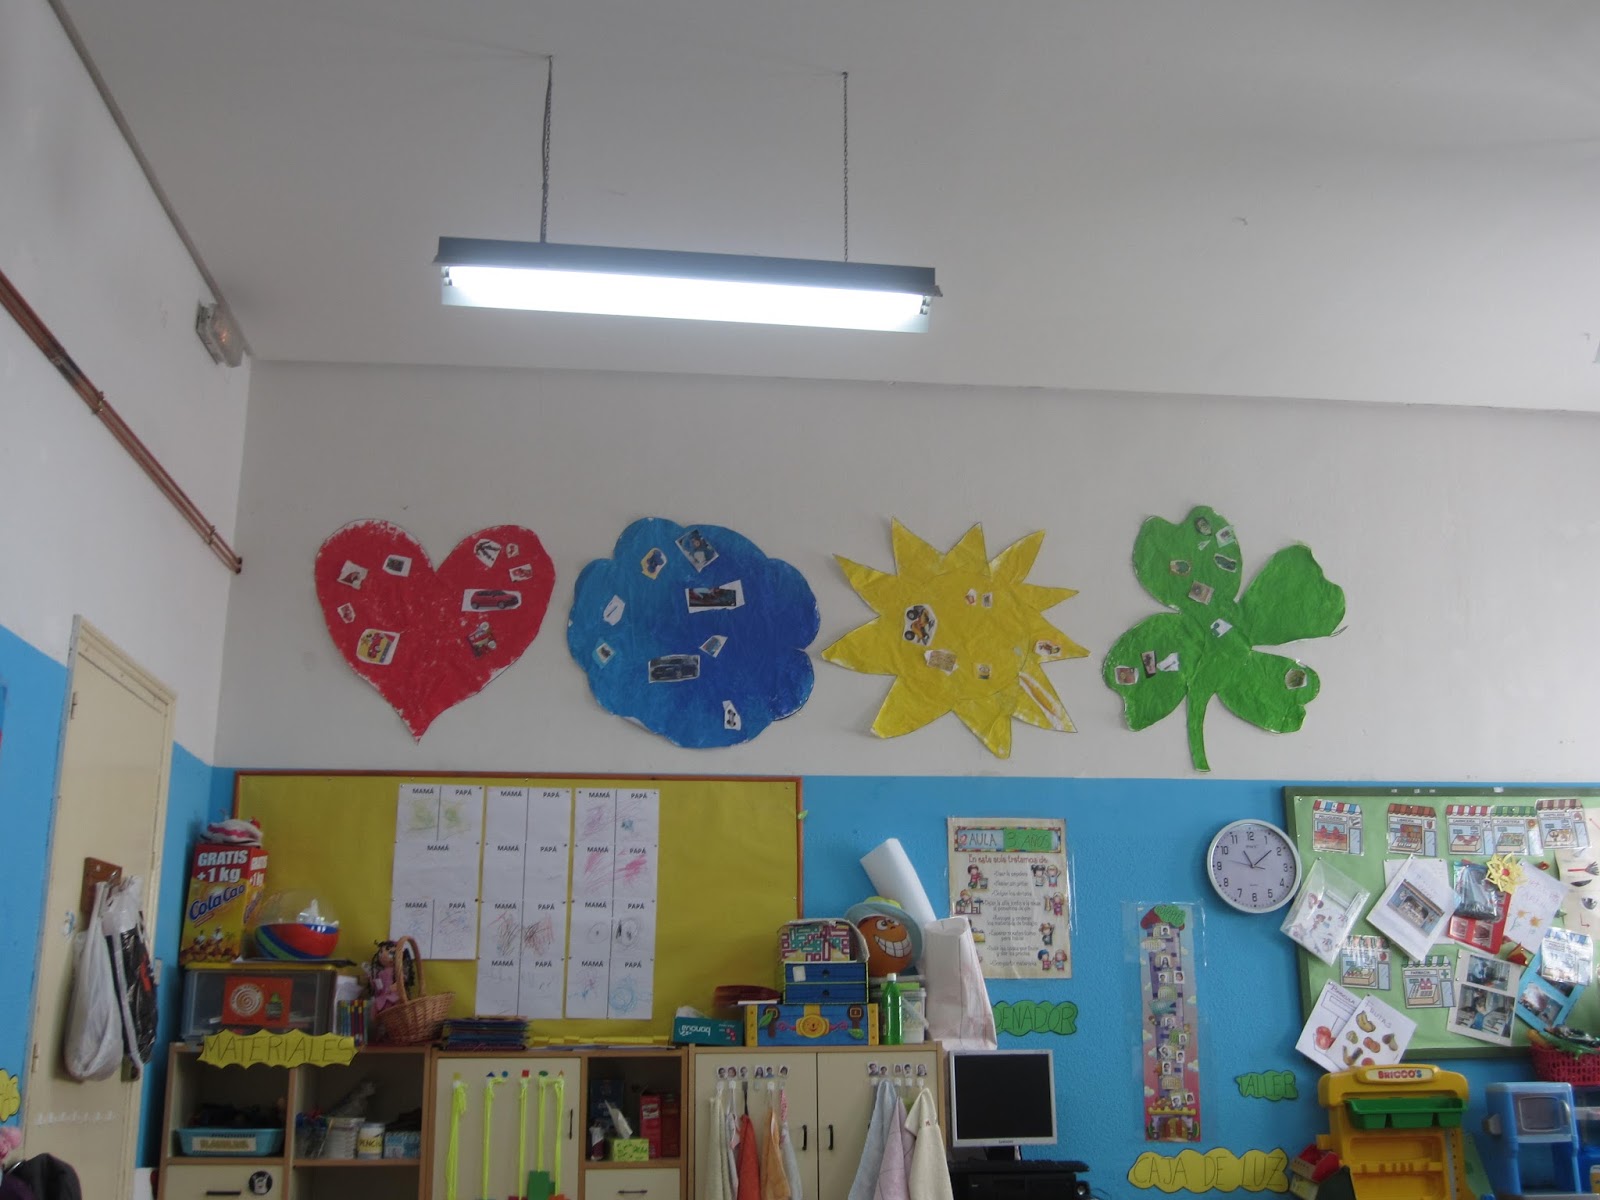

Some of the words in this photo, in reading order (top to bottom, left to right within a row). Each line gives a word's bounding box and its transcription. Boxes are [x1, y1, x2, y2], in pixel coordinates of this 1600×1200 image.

[412, 787, 434, 795] MAMÁ
[455, 788, 472, 796] PAPÁ
[500, 789, 522, 797] MAMÁ
[969, 833, 997, 847] AULA
[1007, 831, 1017, 847] 3
[1231, 834, 1238, 844] 11
[1246, 831, 1254, 841] 12
[1264, 835, 1268, 845] 1
[427, 844, 449, 852] MAMÁ
[540, 845, 557, 853] PAPÁ
[587, 846, 609, 854] MAMÁ
[629, 847, 647, 855] PAPÁ
[1221, 846, 1229, 855] 10
[1276, 847, 1282, 856] 2
[197, 850, 248, 867] GRATIS
[1216, 861, 1222, 870] 9
[1283, 863, 1288, 872] 3
[219, 867, 241, 883] kg
[1223, 877, 1229, 887] 8
[1280, 878, 1285, 887] 4
[1237, 888, 1243, 898] 7
[1252, 893, 1257, 902] 6
[1268, 889, 1273, 898] 5
[405, 901, 428, 909] MAMÁ
[494, 902, 517, 910] MAMÁ
[537, 903, 555, 911] PAPÁ
[585, 901, 607, 909] MAMÁ
[627, 902, 645, 910] PAPÁ
[535, 960, 552, 968] PAPÁ
[581, 960, 604, 968] MAMÁ
[625, 961, 642, 969] PAPÁ
[204, 1035, 353, 1063] MATERIALES
[1378, 1069, 1422, 1079] BRICCO'S
[1133, 1155, 1187, 1189] CAJA
[1204, 1156, 1224, 1186] DE
[1241, 1155, 1284, 1188] LUZ
